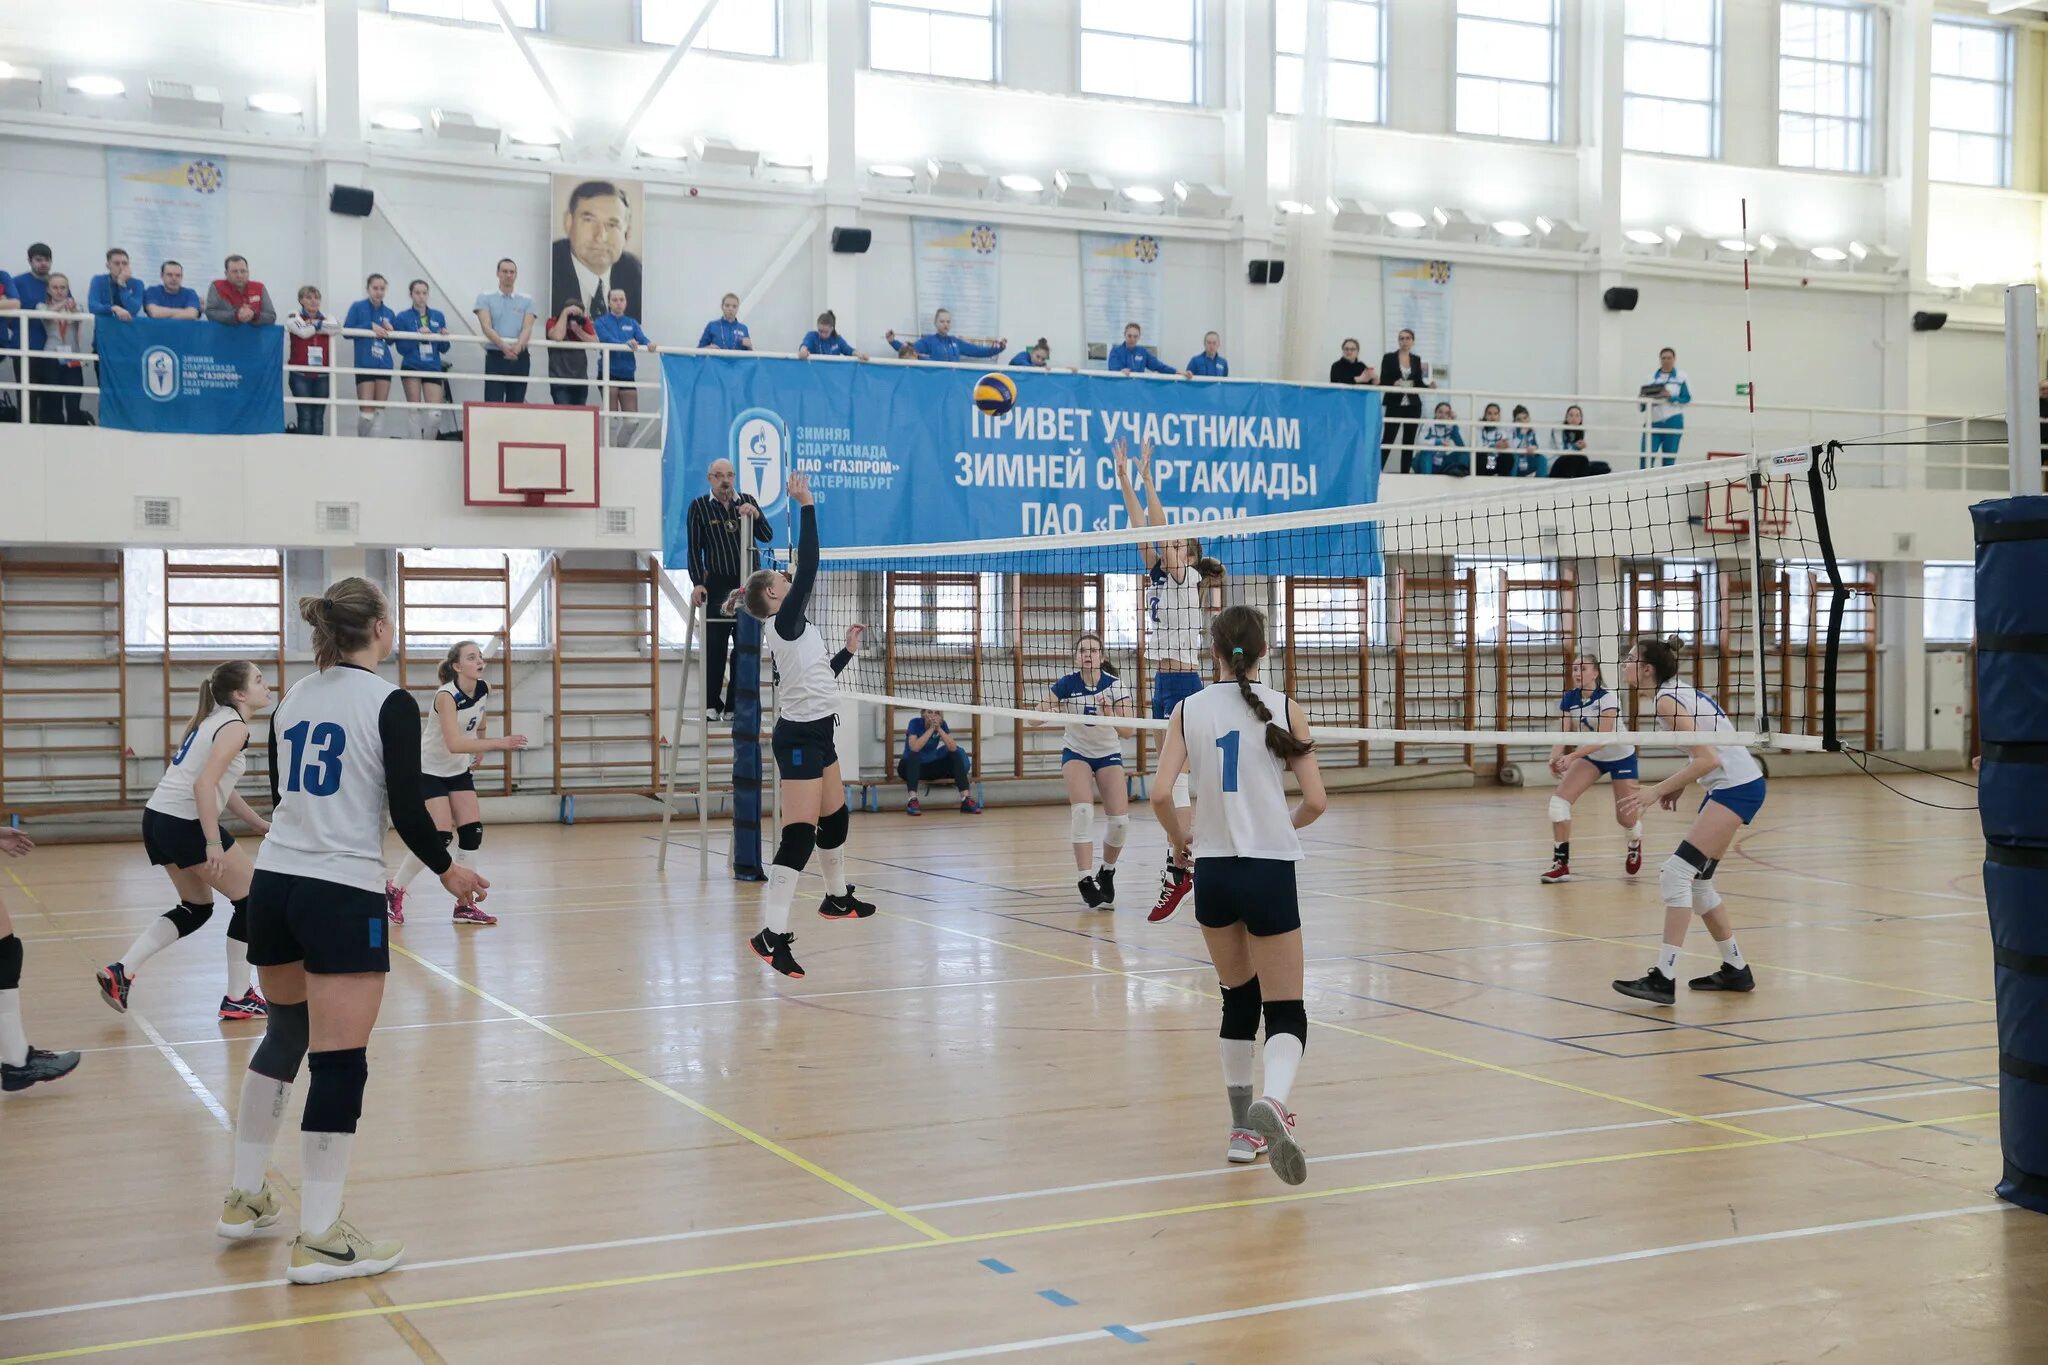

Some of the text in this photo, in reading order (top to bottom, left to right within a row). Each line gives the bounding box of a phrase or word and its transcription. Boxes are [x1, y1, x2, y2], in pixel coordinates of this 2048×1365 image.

[796, 426, 850, 440] ЗИМНЯЯ
[972, 404, 1300, 449] ПРИВЕТ УЧАСТНИКАМ
[796, 443, 888, 459] СПАРТАКИАДА
[797, 458, 900, 474] ПАО «ГАЗПРОМ»
[954, 447, 1086, 489] ЗИМНЕЙ
[804, 474, 893, 490] КАТЕРИНБУРГ
[1022, 502, 1083, 535] ПАО
[466, 716, 477, 732] 5
[283, 719, 347, 797] 13
[1215, 730, 1241, 793] 1
